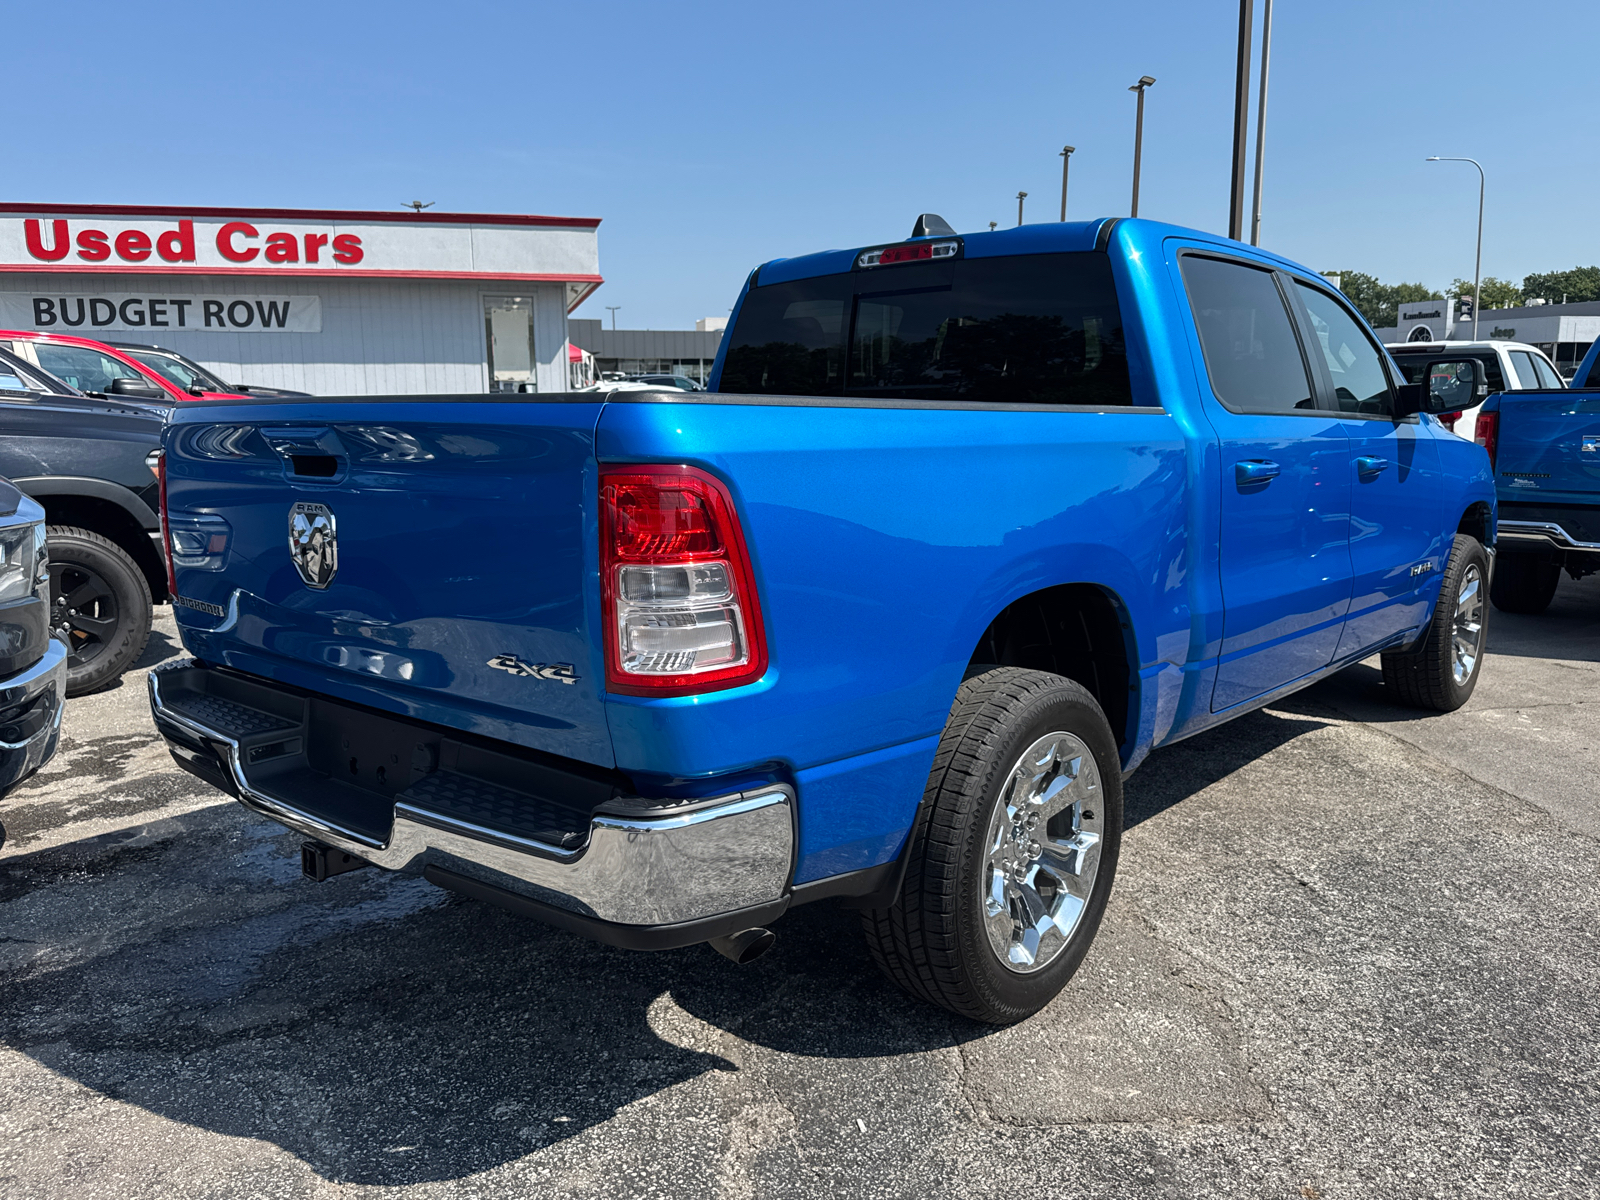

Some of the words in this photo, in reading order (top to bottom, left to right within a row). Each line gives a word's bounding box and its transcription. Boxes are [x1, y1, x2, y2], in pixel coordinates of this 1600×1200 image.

[24, 219, 196, 261] Used
[216, 221, 364, 263] Cars
[33, 297, 193, 327] BUDGET
[203, 299, 291, 328] ROW
[1490, 326, 1516, 339] Jeep
[296, 504, 323, 513] RAM
